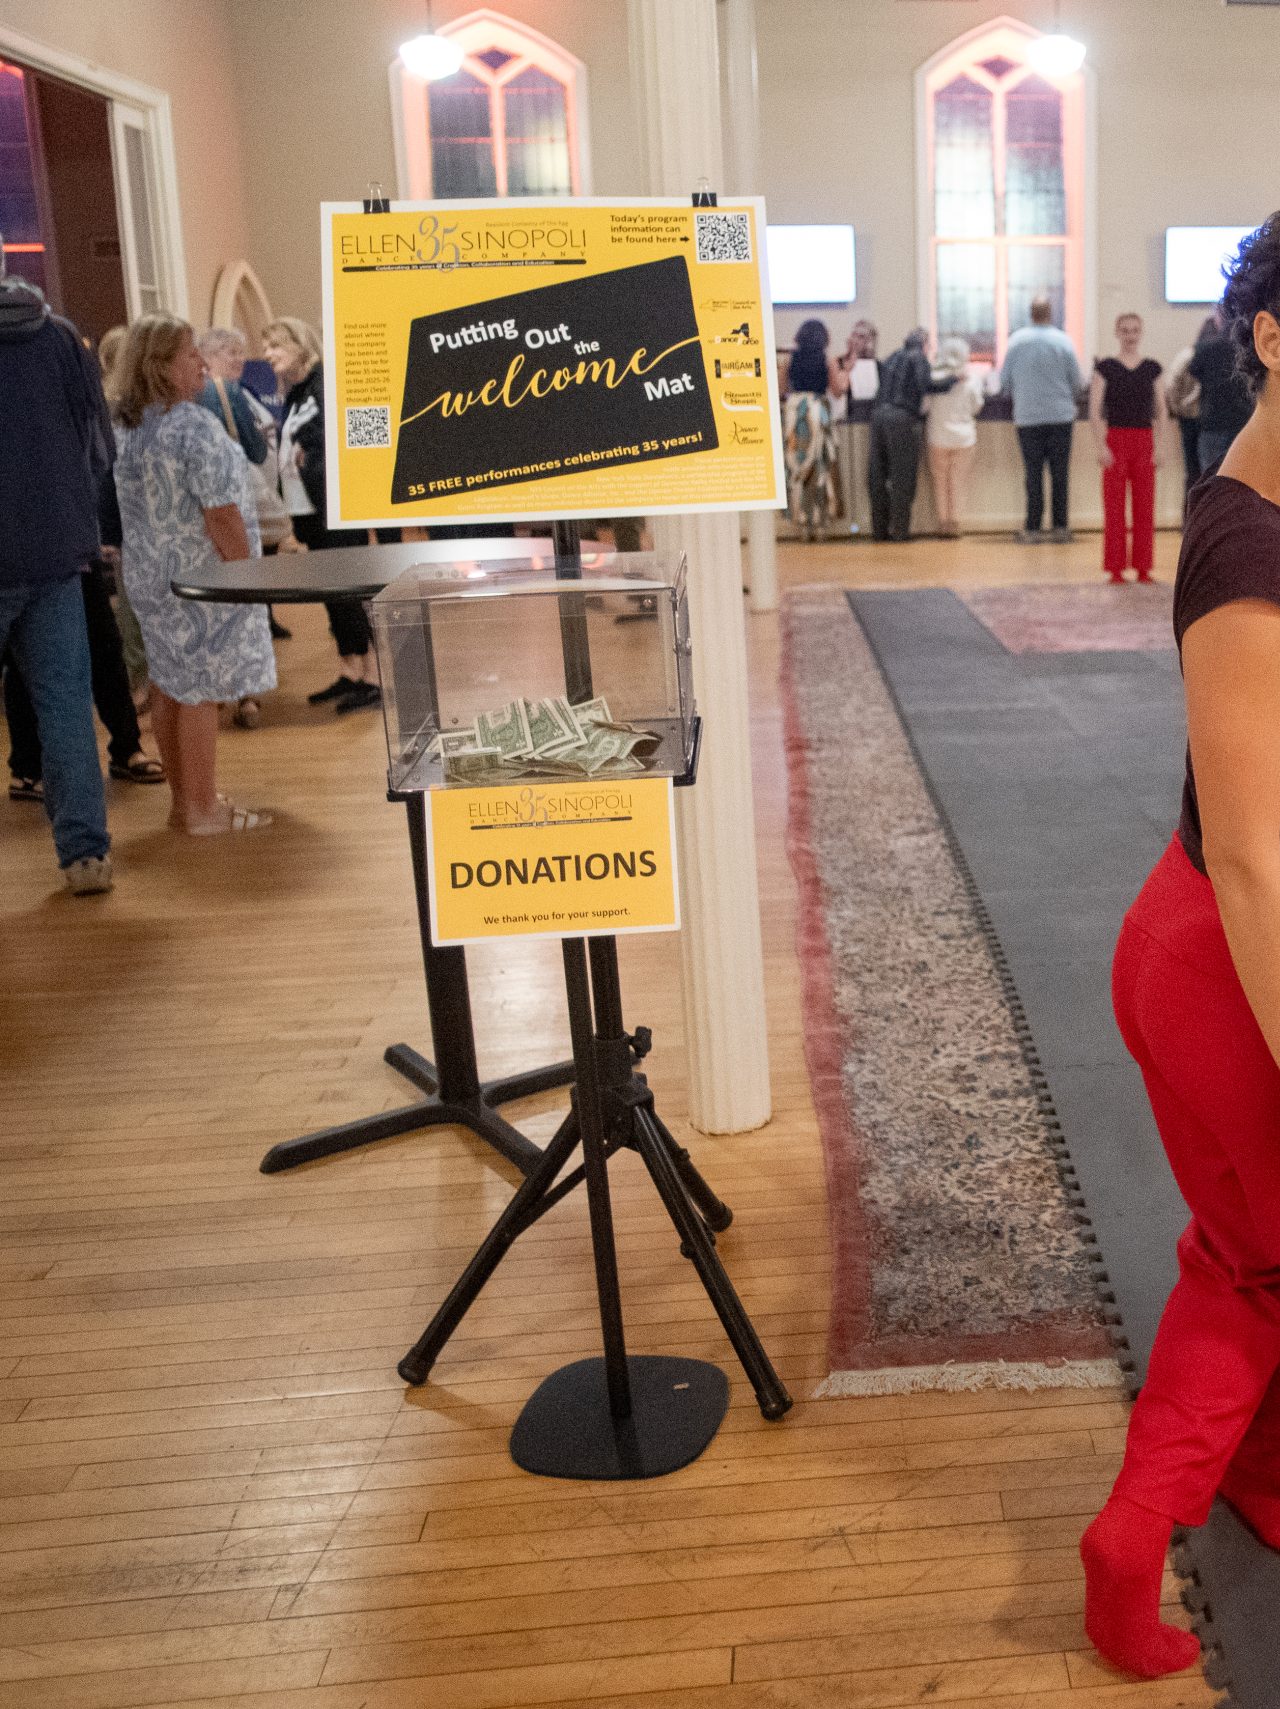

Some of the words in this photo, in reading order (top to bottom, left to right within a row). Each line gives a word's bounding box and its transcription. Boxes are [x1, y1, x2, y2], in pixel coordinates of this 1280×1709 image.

[610, 214, 645, 223] Today's
[648, 216, 687, 224] program
[610, 225, 663, 233] information
[341, 233, 415, 254] ELLEN
[417, 215, 460, 273] 35
[461, 229, 586, 250] SINOPOLI
[611, 235, 623, 243] be
[626, 235, 653, 243] found
[656, 235, 677, 243] here
[429, 318, 520, 353] Putting
[524, 323, 571, 349] Out
[573, 339, 600, 355] the
[423, 347, 662, 418] welcome
[644, 373, 695, 401] Mat
[408, 484, 425, 496] 35
[429, 476, 462, 492] FREE
[466, 459, 561, 487] performances
[564, 444, 640, 467] celebrating
[642, 440, 659, 451] 35
[661, 431, 703, 450] years!
[468, 801, 519, 818] ELLEN
[519, 787, 549, 829] 35
[548, 794, 632, 813] SINOPOLI
[450, 849, 657, 889] DONATIONS
[483, 915, 499, 925] We
[502, 913, 529, 924] thank
[532, 914, 550, 926] you
[551, 911, 566, 921] for
[568, 912, 589, 924] your
[591, 907, 631, 922] support.
